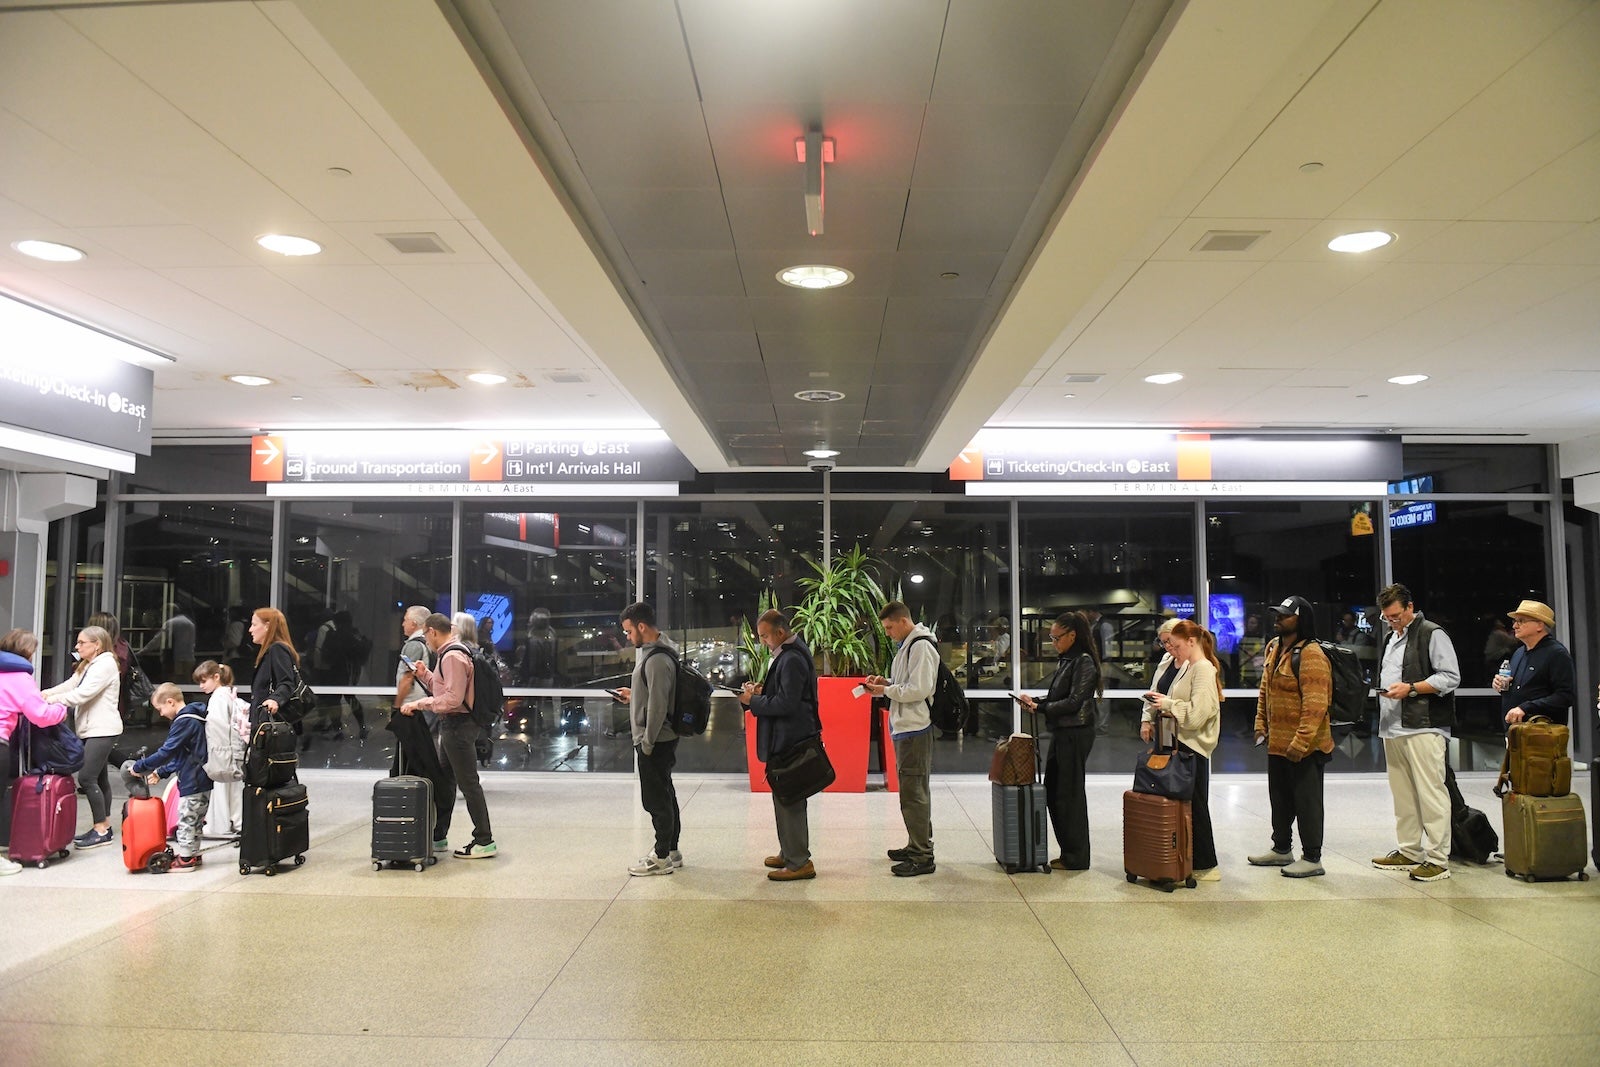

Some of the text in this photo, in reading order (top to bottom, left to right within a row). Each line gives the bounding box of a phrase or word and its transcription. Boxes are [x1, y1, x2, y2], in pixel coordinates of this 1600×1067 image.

[121, 397, 146, 418] East
[526, 440, 579, 457] Parking
[600, 441, 630, 454] East
[305, 461, 462, 477] Ground Transportation
[526, 462, 641, 474] Int'l Arrivals Hall
[1007, 460, 1124, 475] Ticketing/Check-In
[1141, 461, 1170, 473] East
[408, 484, 534, 493] TERMINAL A East
[1113, 483, 1200, 492] TERMINAL
[1211, 483, 1218, 491] A
